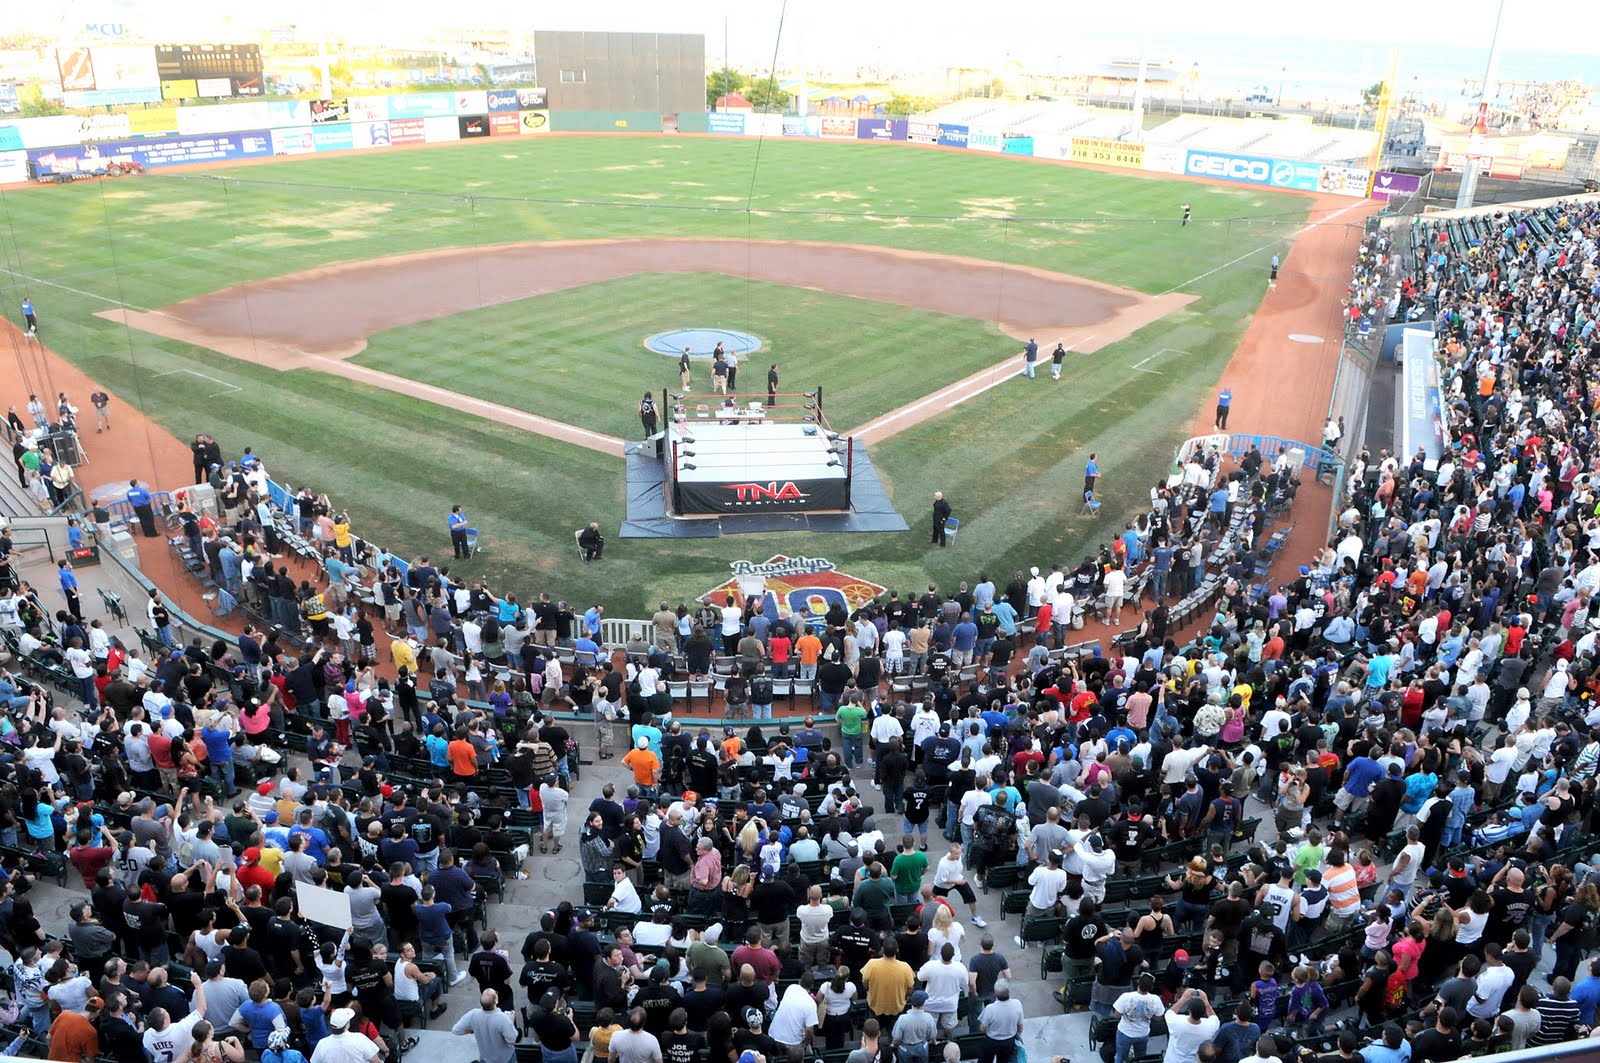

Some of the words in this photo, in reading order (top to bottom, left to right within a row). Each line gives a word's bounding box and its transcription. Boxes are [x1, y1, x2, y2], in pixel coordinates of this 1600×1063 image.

[86, 23, 124, 36] MCU
[498, 95, 517, 106] pepsi
[1071, 138, 1090, 146] SEND
[1100, 141, 1113, 149] THE
[1114, 142, 1146, 153] CLOWNS
[1072, 149, 1088, 157] 718
[1092, 151, 1111, 160] 353
[1116, 154, 1141, 164] 8446
[1188, 155, 1269, 181] GEICO
[1346, 173, 1368, 182] Gold's
[719, 481, 812, 501] TNA
[730, 556, 835, 576] Brooklyn
[915, 799, 924, 810] 7
[118, 858, 139, 872] 20
[161, 1050, 174, 1063] 7
